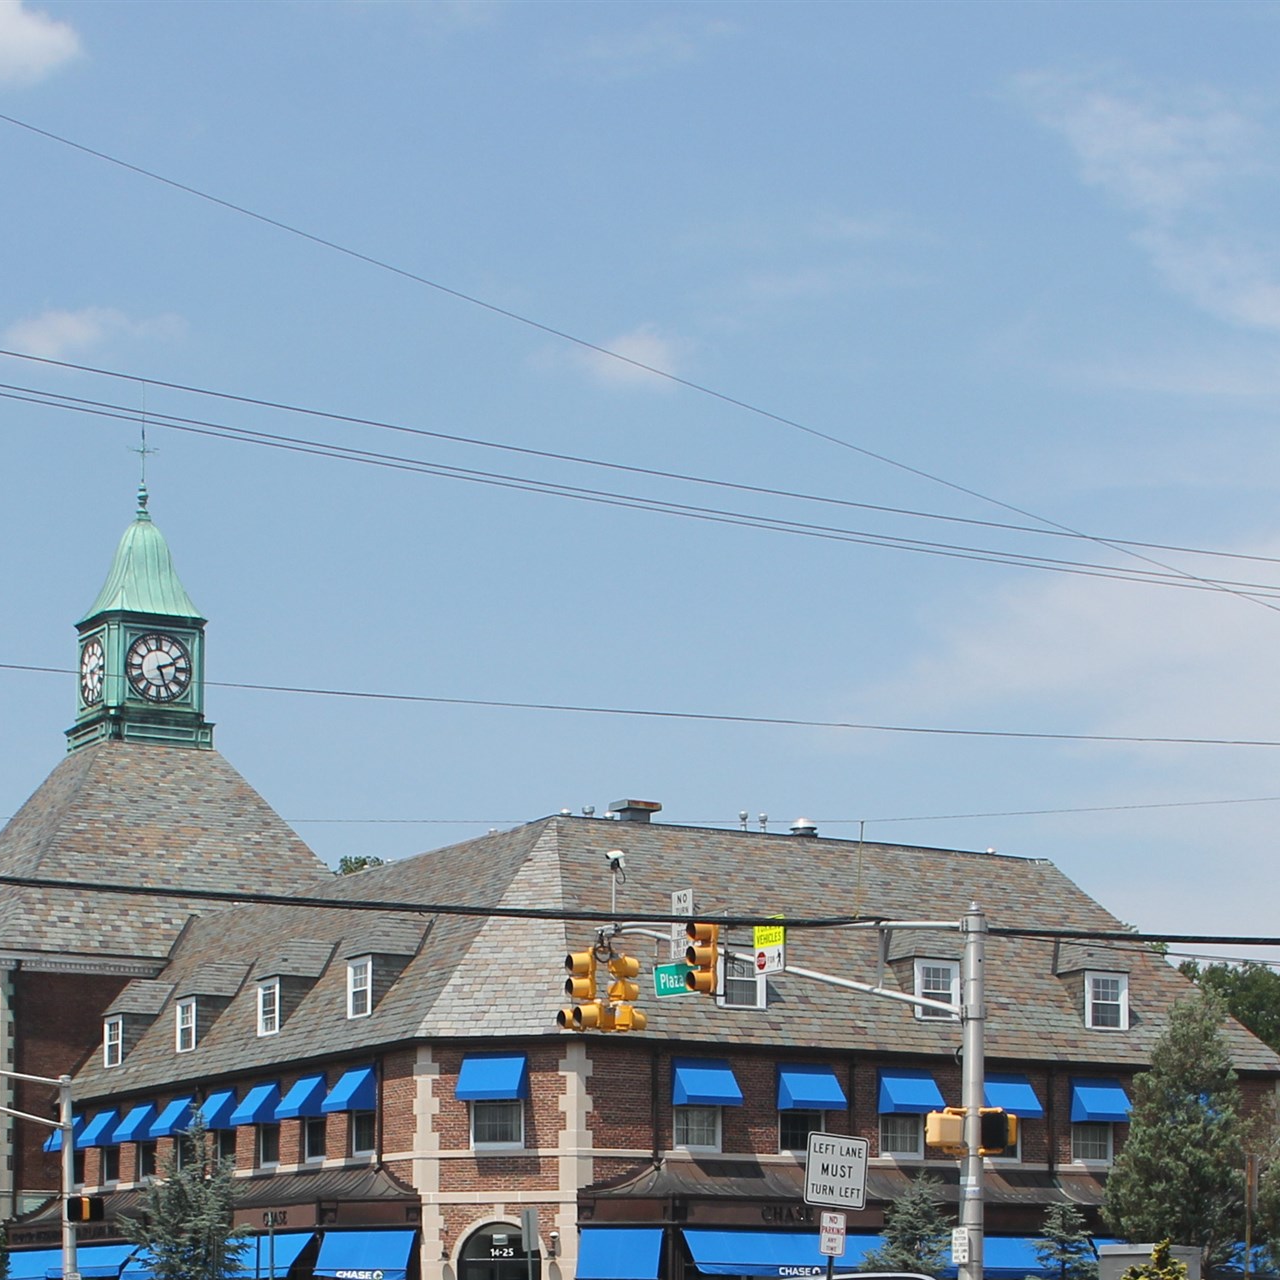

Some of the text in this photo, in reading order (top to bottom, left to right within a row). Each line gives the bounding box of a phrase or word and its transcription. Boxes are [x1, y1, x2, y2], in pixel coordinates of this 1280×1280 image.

[676, 893, 688, 905] NO
[660, 973, 685, 989] Plaza
[813, 1142, 863, 1159] LEFT LANE
[820, 1163, 854, 1179] MUST
[811, 1182, 861, 1199] TURN LEFT
[761, 1206, 814, 1222] CHASE
[829, 1216, 839, 1224] NO
[821, 1226, 845, 1236] PARKING
[335, 1270, 373, 1280] CHASE
[778, 1266, 812, 1276] CHASE
